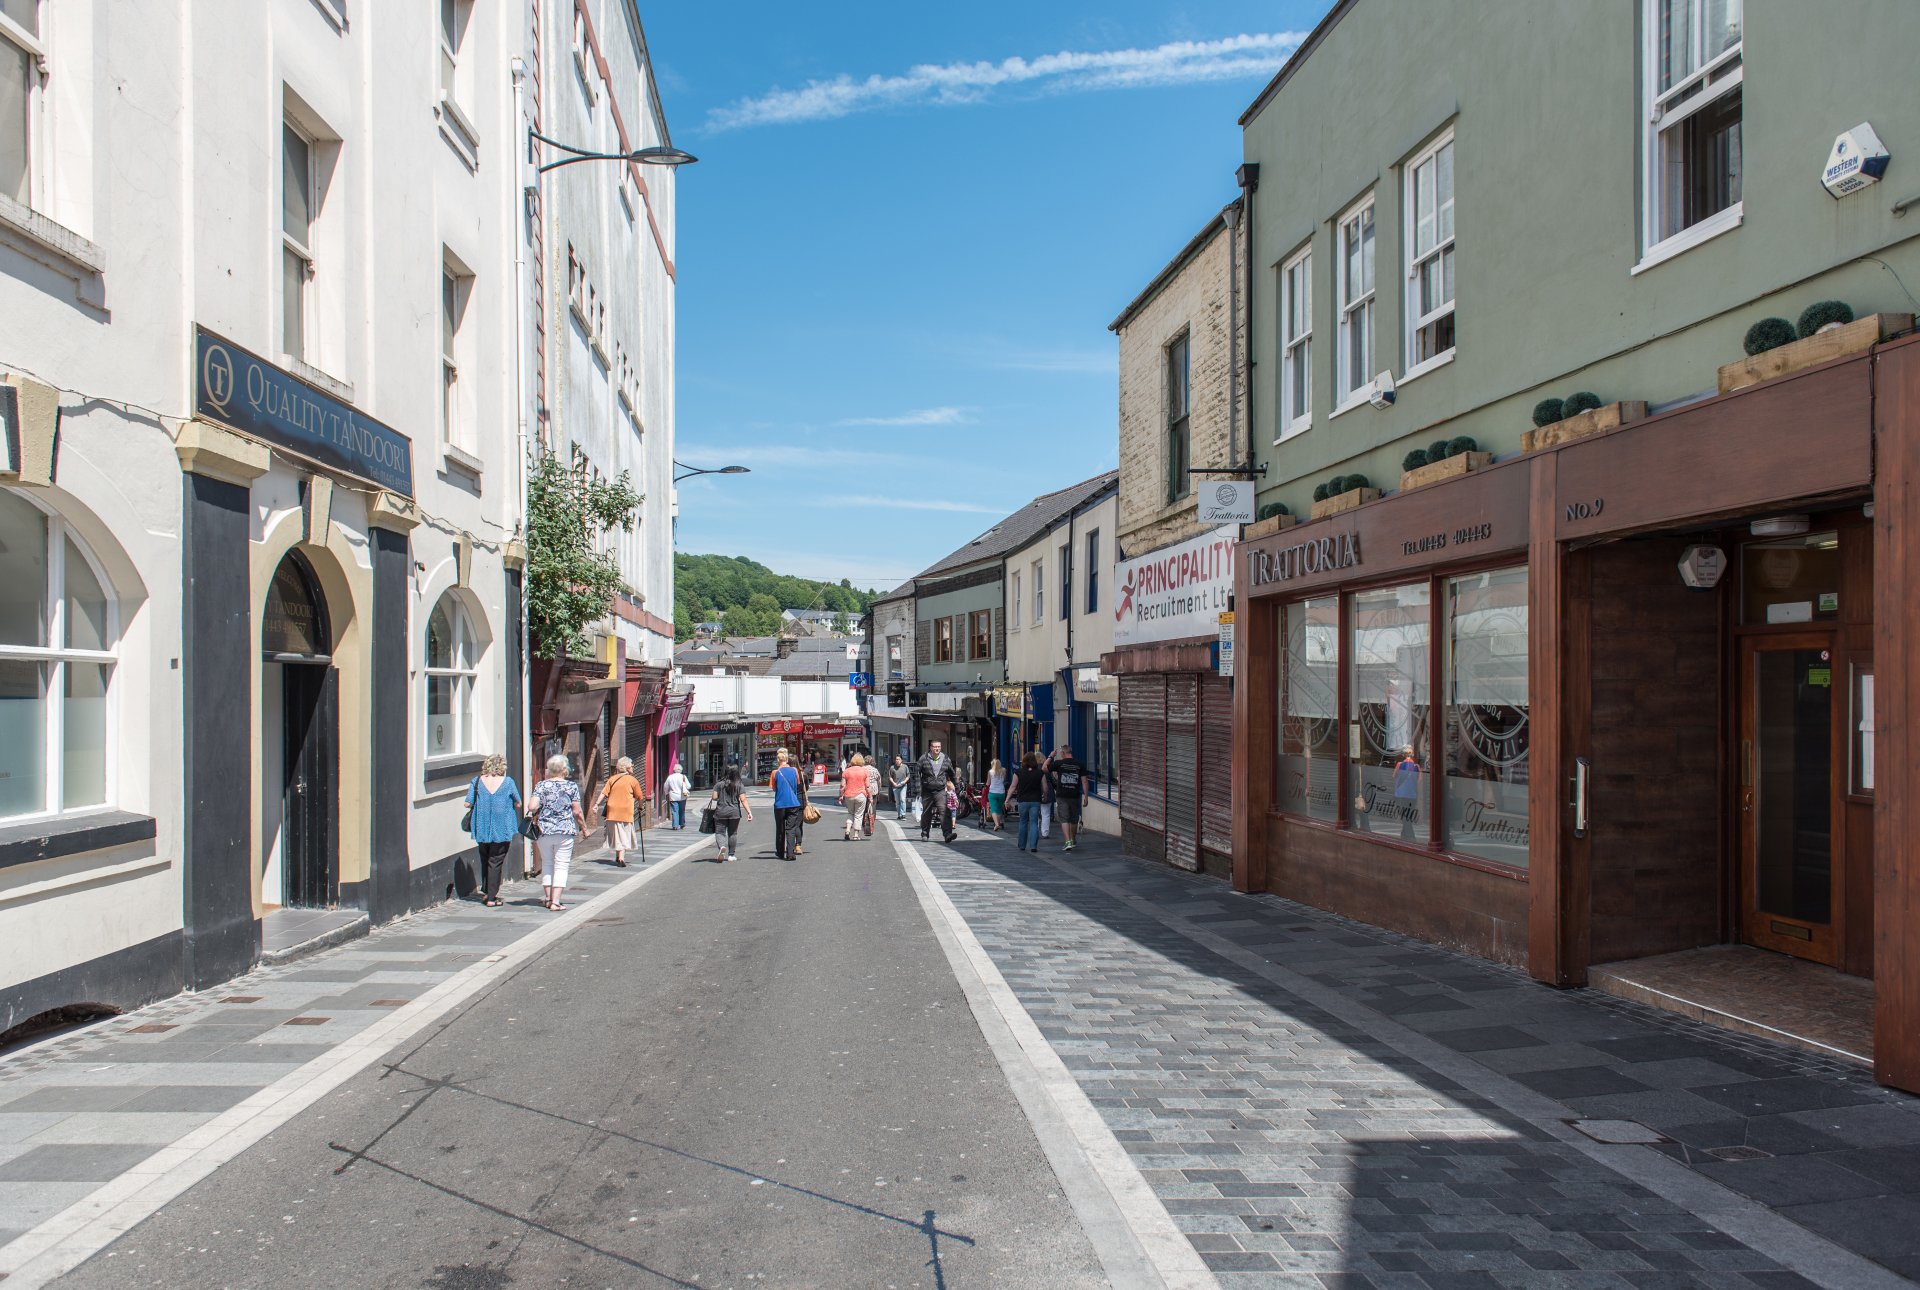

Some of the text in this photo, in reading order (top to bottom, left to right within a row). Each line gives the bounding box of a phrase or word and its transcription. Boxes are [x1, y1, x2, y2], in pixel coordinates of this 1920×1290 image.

[1827, 156, 1858, 177] WESTERN
[247, 363, 405, 474] QUALITY TANDOORI
[1203, 506, 1250, 521] Trattoria
[1452, 522, 1492, 545] 404443
[1138, 537, 1235, 598] PRINCIPALITY
[1247, 529, 1360, 586] TRATTORIA
[271, 600, 314, 618] TANDOORI
[1138, 580, 1235, 623] Recruitment Ltd
[1363, 782, 1419, 823] Trattoria
